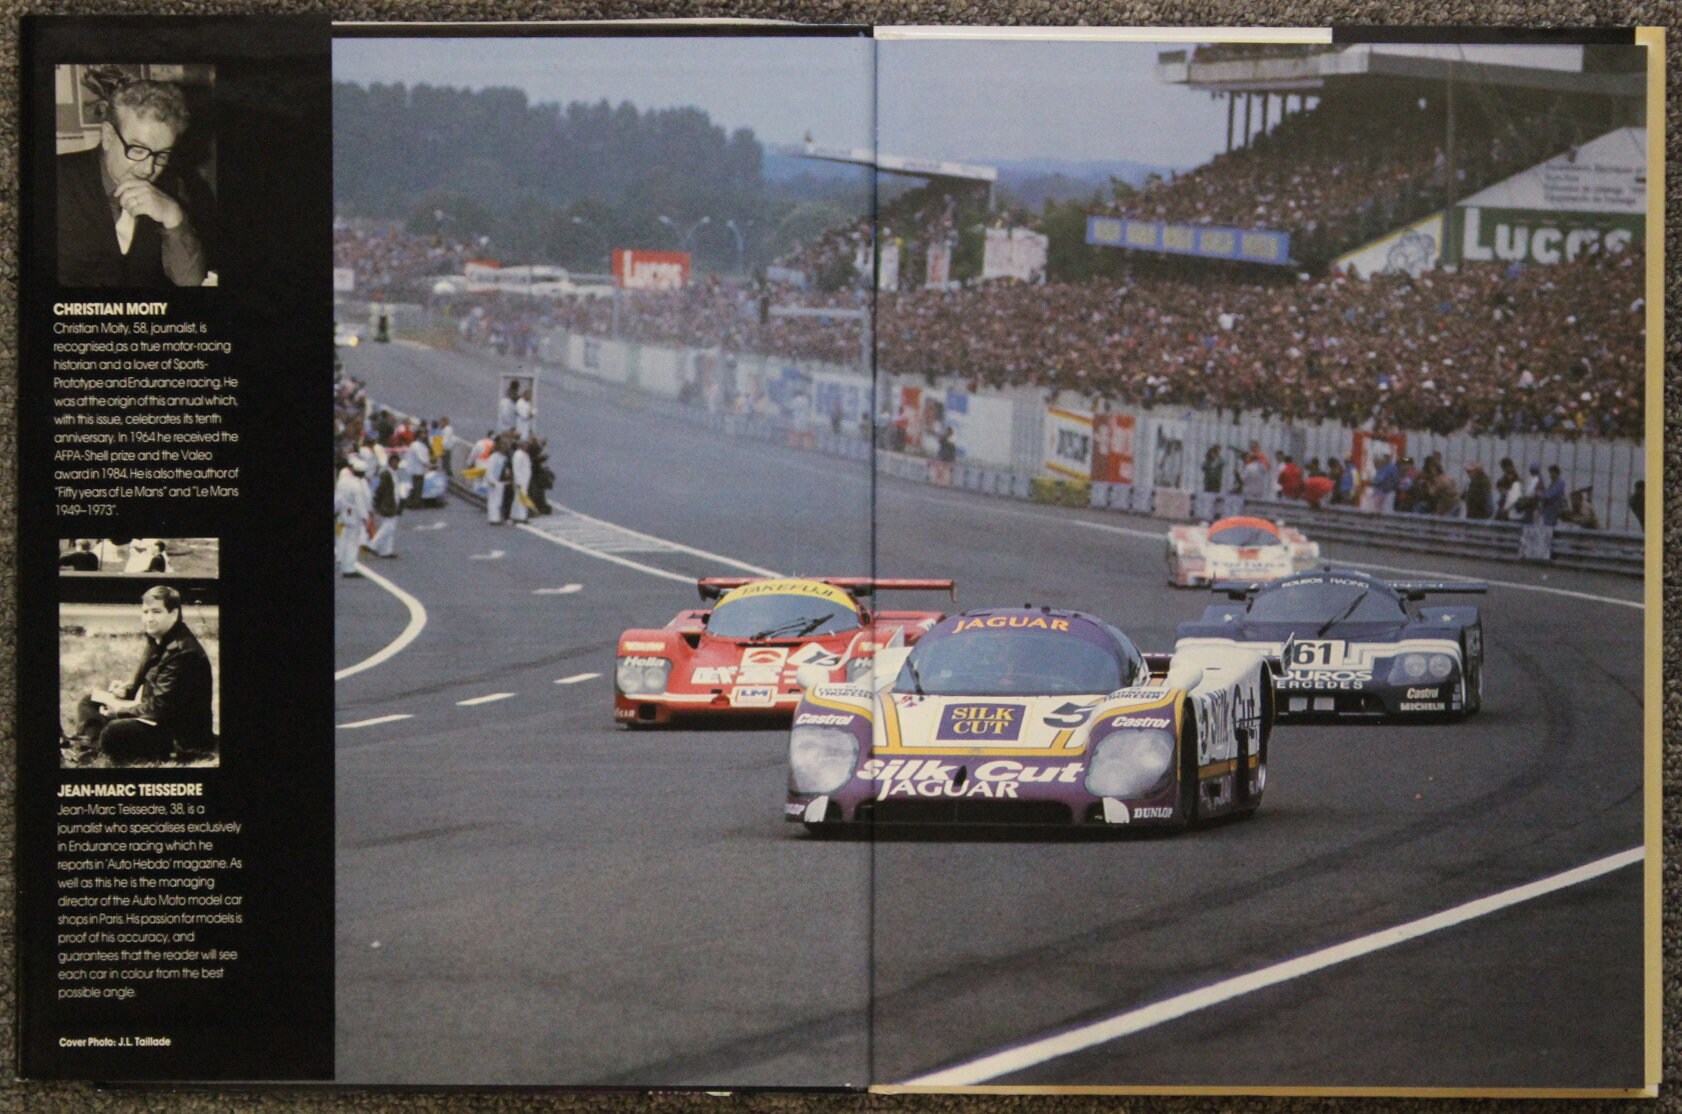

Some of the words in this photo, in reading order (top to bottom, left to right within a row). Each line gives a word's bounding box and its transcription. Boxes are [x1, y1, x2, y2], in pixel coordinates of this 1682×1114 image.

[53, 303, 124, 315] CHRISTIAN
[126, 303, 168, 315] MOITY
[53, 322, 98, 334] Christian
[200, 323, 207, 333] is
[53, 341, 113, 354] recognised
[116, 343, 128, 353] as
[130, 343, 138, 351] a
[140, 342, 160, 351] true
[163, 341, 231, 353] motor-racing
[53, 360, 96, 370] historian
[99, 360, 121, 370] and
[123, 361, 131, 369] a
[134, 360, 159, 369] lover
[161, 359, 172, 369] of
[174, 358, 208, 370] Sports-
[53, 377, 103, 390] Prototype
[105, 378, 127, 388] and
[128, 377, 185, 388] Endurance
[224, 377, 238, 387] He
[53, 398, 75, 406] was
[77, 396, 89, 406] at
[89, 396, 107, 406] the
[107, 396, 136, 409] origin
[138, 395, 149, 406] of
[149, 396, 166, 406] this
[167, 396, 205, 406] annual
[54, 414, 75, 424] with
[77, 414, 94, 424] this
[125, 414, 181, 424] celebrates
[183, 414, 193, 424] its
[195, 413, 221, 424] tenth
[118, 432, 127, 442] In
[130, 431, 156, 442] 1964
[157, 432, 171, 442] he
[173, 432, 220, 442] received
[222, 432, 239, 442] the
[54, 450, 108, 461] AFPA-Shell
[111, 450, 135, 462] prize
[138, 450, 160, 460] and
[162, 450, 179, 460] the
[181, 450, 212, 460] Valeo
[54, 469, 89, 479] award
[90, 469, 99, 478] in
[130, 469, 144, 479] He
[145, 469, 152, 479] is
[153, 468, 174, 479] also
[175, 468, 192, 479] the
[193, 468, 227, 478] author
[228, 468, 239, 478] of
[79, 489, 107, 499] years
[108, 487, 120, 497] of
[121, 487, 132, 497] Le
[169, 487, 190, 497] and
[210, 486, 239, 496] Mans
[1330, 578, 1370, 589] RACING
[952, 616, 1070, 634] JAGUAR
[1293, 642, 1332, 665] 61
[623, 655, 666, 667] Hella
[1407, 688, 1439, 699] Castrol
[1400, 702, 1446, 711] MICHELIN
[795, 713, 855, 726] Castrol
[952, 707, 1016, 721] SILK
[1043, 702, 1100, 728] 5
[952, 721, 1009, 735] CUT
[1111, 716, 1171, 729] Castrol
[856, 759, 958, 783] Silk
[974, 760, 1085, 783] Cut
[57, 784, 136, 797] JEAN-MARC
[138, 783, 203, 796] TEISSEDRE
[876, 779, 1020, 801] JAGUAR
[57, 804, 116, 815] Jean-Marc
[187, 805, 194, 814] is
[197, 805, 205, 814] a
[1133, 807, 1173, 819] DUNLOP
[57, 823, 102, 834] journalist
[105, 823, 127, 833] who
[130, 822, 185, 834] specialises
[187, 822, 241, 833] exclusively
[58, 843, 67, 851] in
[69, 840, 126, 851] Endurance
[129, 841, 163, 853] racing
[165, 840, 196, 851] which
[199, 841, 213, 850] he
[58, 859, 93, 870] reports
[95, 861, 104, 869] in
[230, 858, 241, 868] As
[58, 878, 78, 888] well
[81, 879, 92, 888] as
[95, 878, 112, 887] this
[114, 878, 128, 887] he
[130, 877, 137, 887] is
[139, 877, 156, 887] the
[159, 877, 215, 890] managing
[58, 896, 98, 906] director
[100, 896, 111, 906] of
[113, 896, 130, 906] the
[132, 895, 157, 905] Auto
[159, 895, 186, 905] Moto
[188, 895, 222, 905] model
[224, 896, 242, 905] car
[58, 915, 88, 926] shops
[89, 914, 98, 924] in
[126, 914, 140, 924] His
[141, 915, 180, 926] passion
[181, 913, 196, 924] for
[196, 913, 234, 923] models
[236, 912, 242, 923] is
[58, 932, 86, 943] proof
[89, 932, 99, 943] of
[102, 932, 115, 942] his
[172, 932, 195, 942] and
[58, 951, 119, 964] guarantees
[121, 951, 142, 960] that
[144, 950, 160, 960] the
[163, 950, 199, 960] reader
[201, 949, 216, 959] will
[219, 951, 238, 960] see
[58, 970, 86, 980] each
[89, 971, 107, 979] car
[109, 970, 119, 978] in
[121, 969, 154, 979] colour
[156, 968, 180, 978] from
[182, 968, 199, 978] the
[202, 968, 224, 978] best
[58, 987, 101, 999] possible
[59, 1038, 86, 1047] Cover
[88, 1037, 116, 1046] Photo:
[135, 1037, 171, 1046] Taillade
